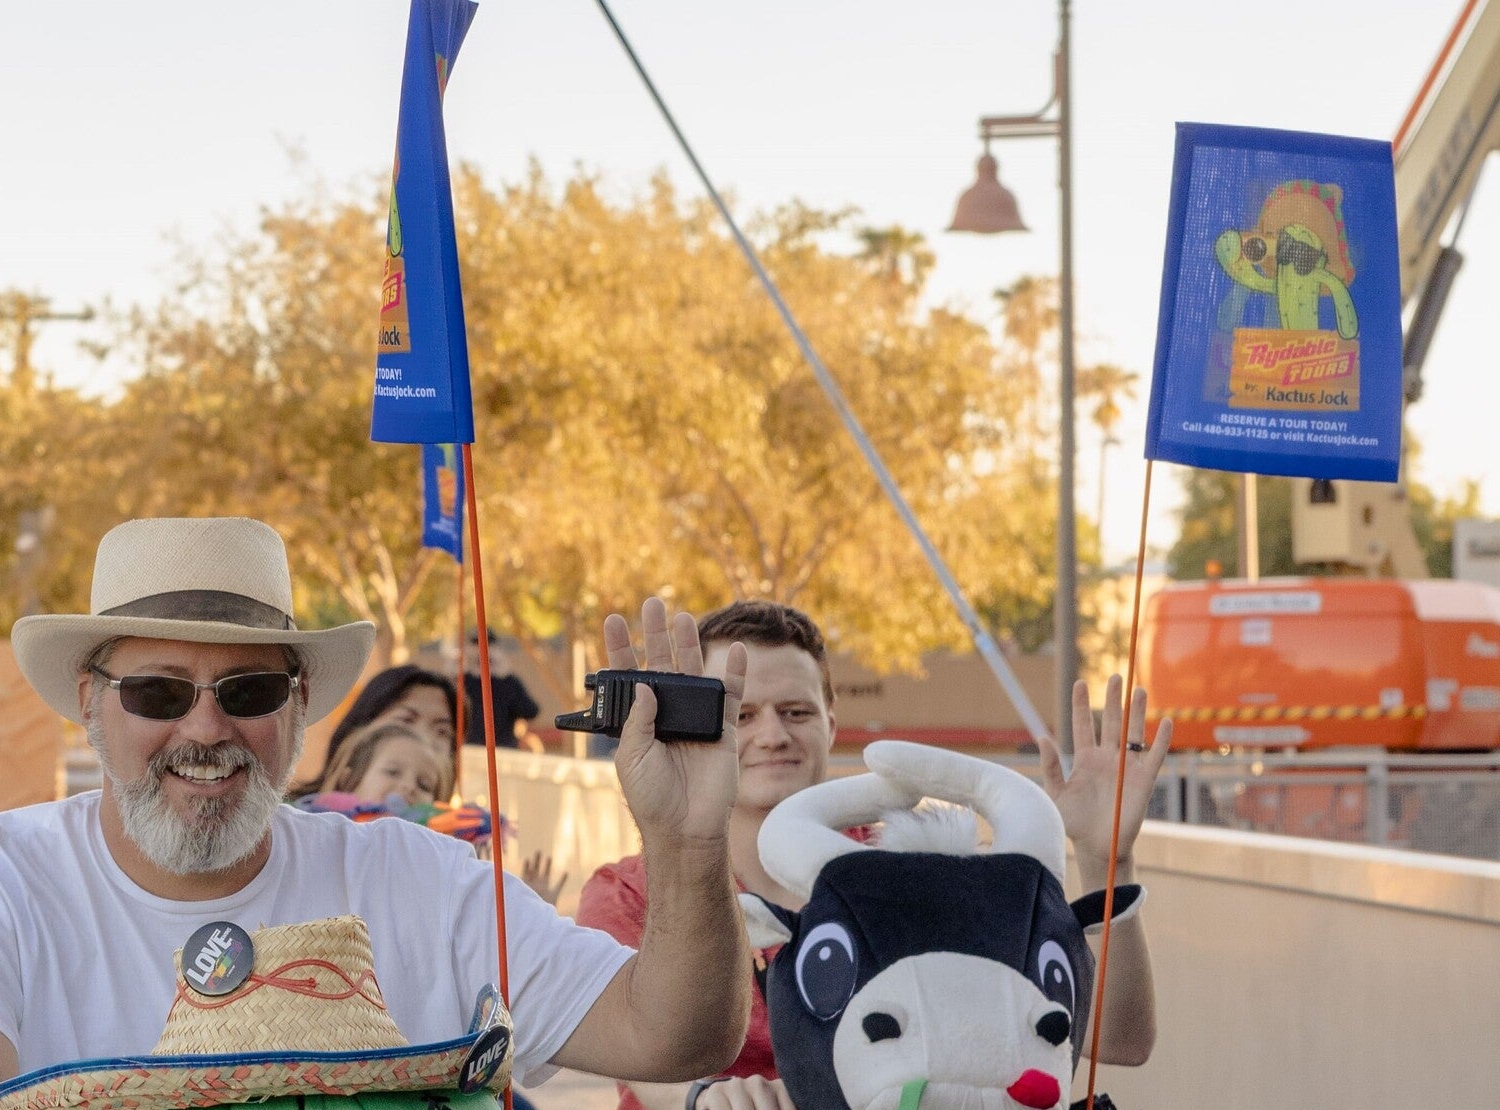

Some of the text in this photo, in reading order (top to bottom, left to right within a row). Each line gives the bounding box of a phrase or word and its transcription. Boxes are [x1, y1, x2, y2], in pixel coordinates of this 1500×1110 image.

[382, 325, 401, 346] Jock
[1243, 336, 1336, 370] Rydable
[378, 368, 402, 380] TODAY!
[1288, 359, 1350, 383] TOURS
[1244, 382, 1259, 392] by:
[1265, 386, 1348, 406] Kactus Jock
[1182, 421, 1201, 432] Call
[1203, 424, 1268, 439] 480-933-1125
[1270, 431, 1282, 440] or
[1283, 431, 1304, 442] visit
[1220, 413, 1347, 431] RESERVE A TOUR TODAY!
[186, 928, 233, 985] LOVE
[468, 1038, 507, 1081] LOVE
